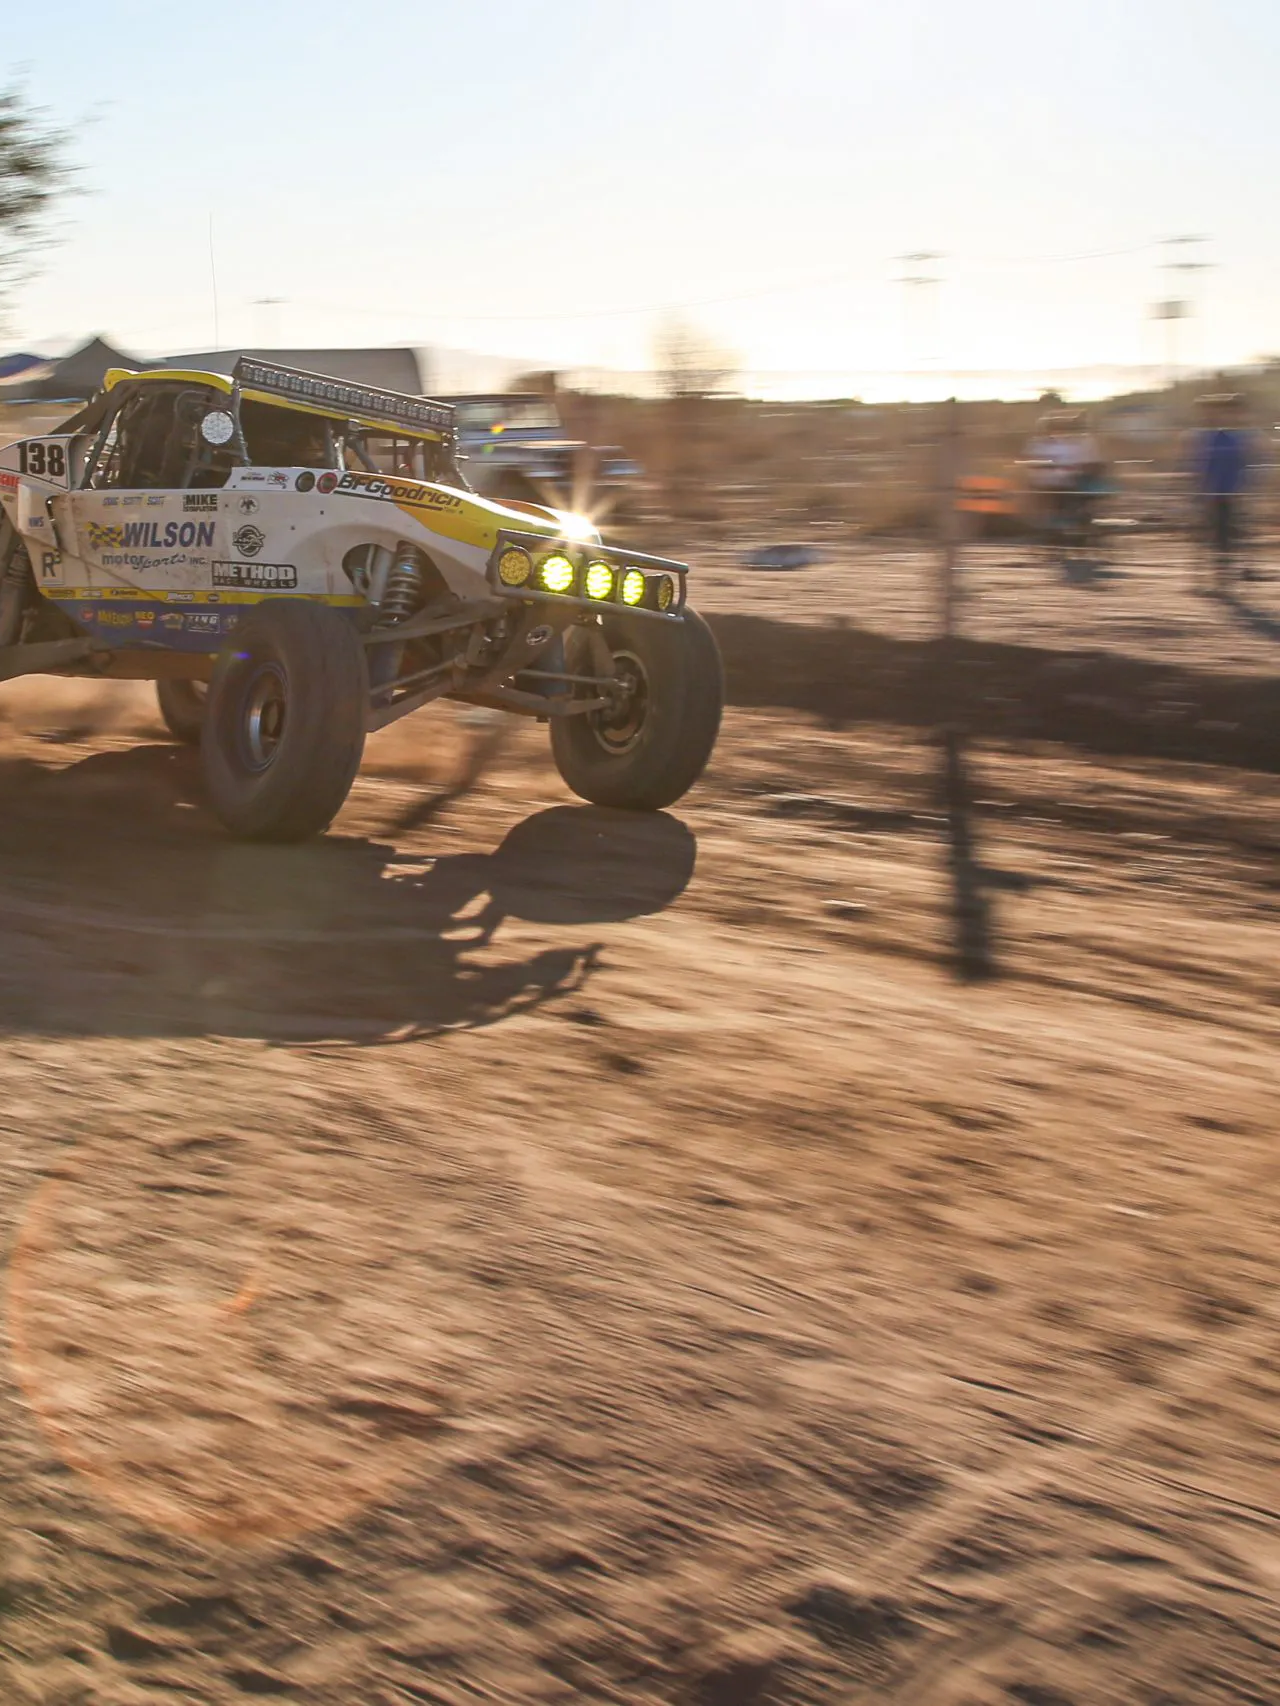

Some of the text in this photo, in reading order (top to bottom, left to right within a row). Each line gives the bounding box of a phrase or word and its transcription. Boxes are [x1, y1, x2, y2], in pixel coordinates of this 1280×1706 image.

[17, 442, 65, 477] 138
[185, 493, 218, 505] MIKE
[338, 474, 461, 508] BFGoodrich
[122, 521, 216, 548] WILSON
[213, 562, 295, 581] METHOD
[243, 578, 296, 588] WHEELS
